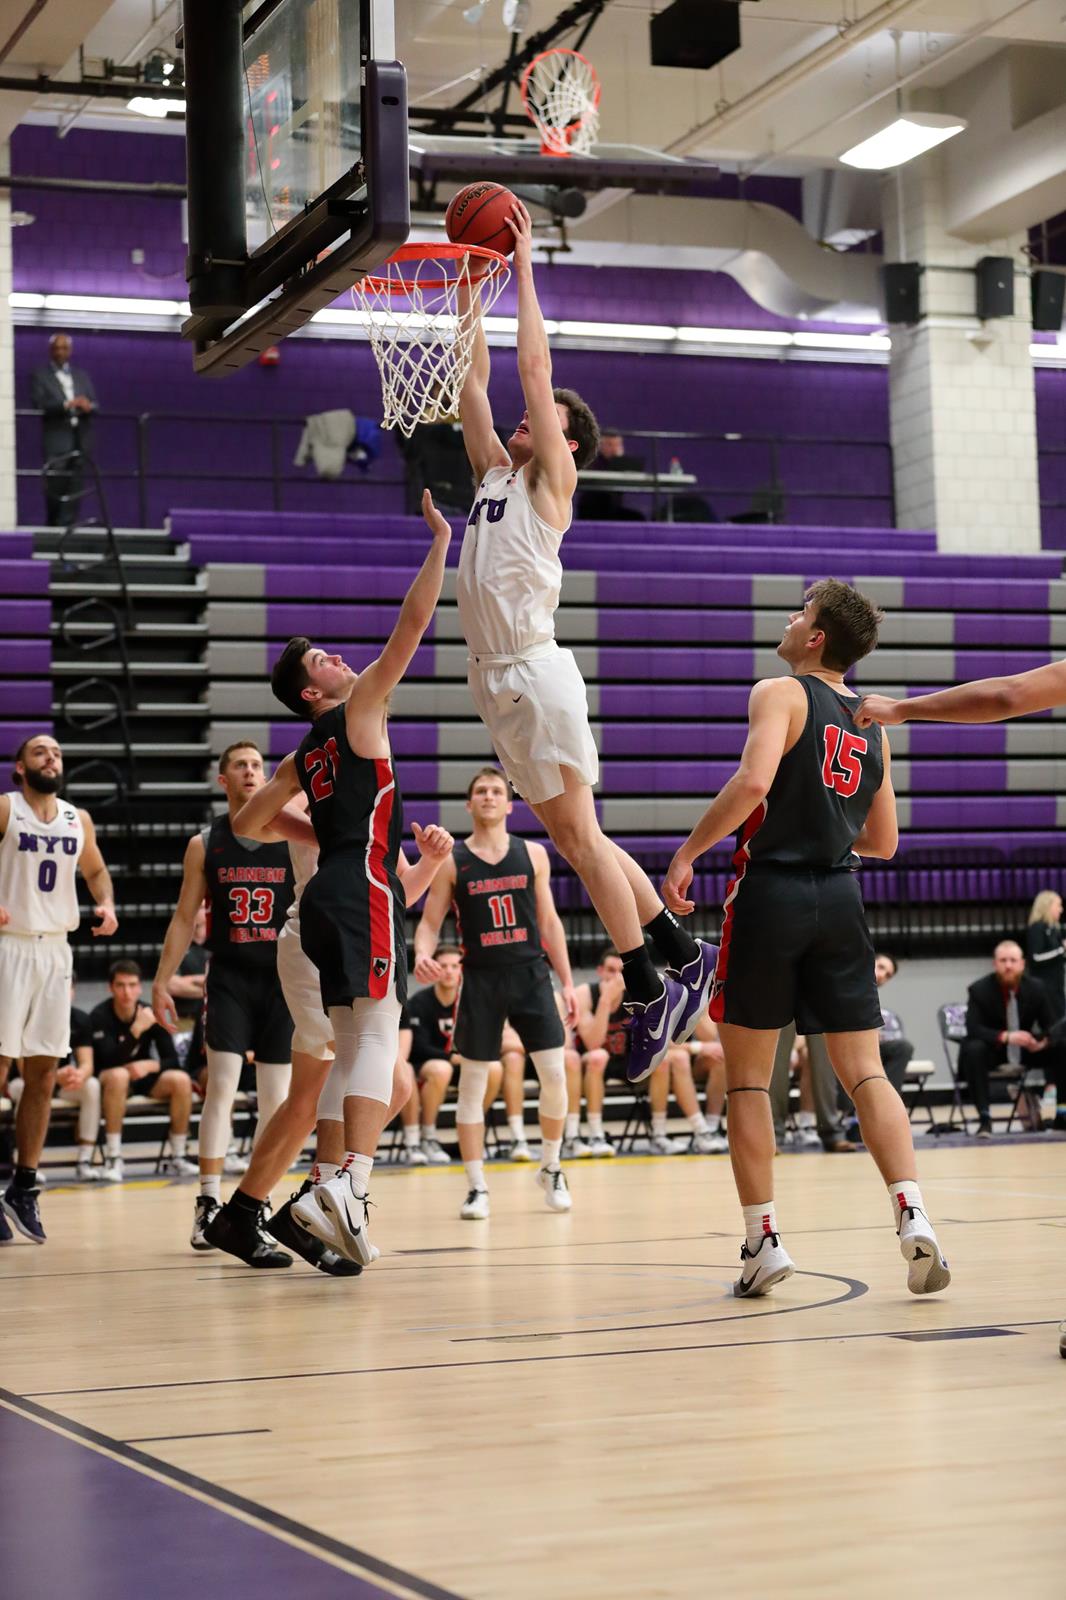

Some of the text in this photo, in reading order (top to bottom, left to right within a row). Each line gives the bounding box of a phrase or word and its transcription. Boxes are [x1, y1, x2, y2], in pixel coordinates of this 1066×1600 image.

[467, 497, 508, 526] YU
[304, 736, 341, 803] 21
[822, 723, 868, 798] 15
[18, 832, 77, 856] NYU
[38, 859, 57, 892] 0
[217, 866, 286, 883] CARNEGIE
[229, 887, 274, 924] 33
[487, 893, 517, 929] 11
